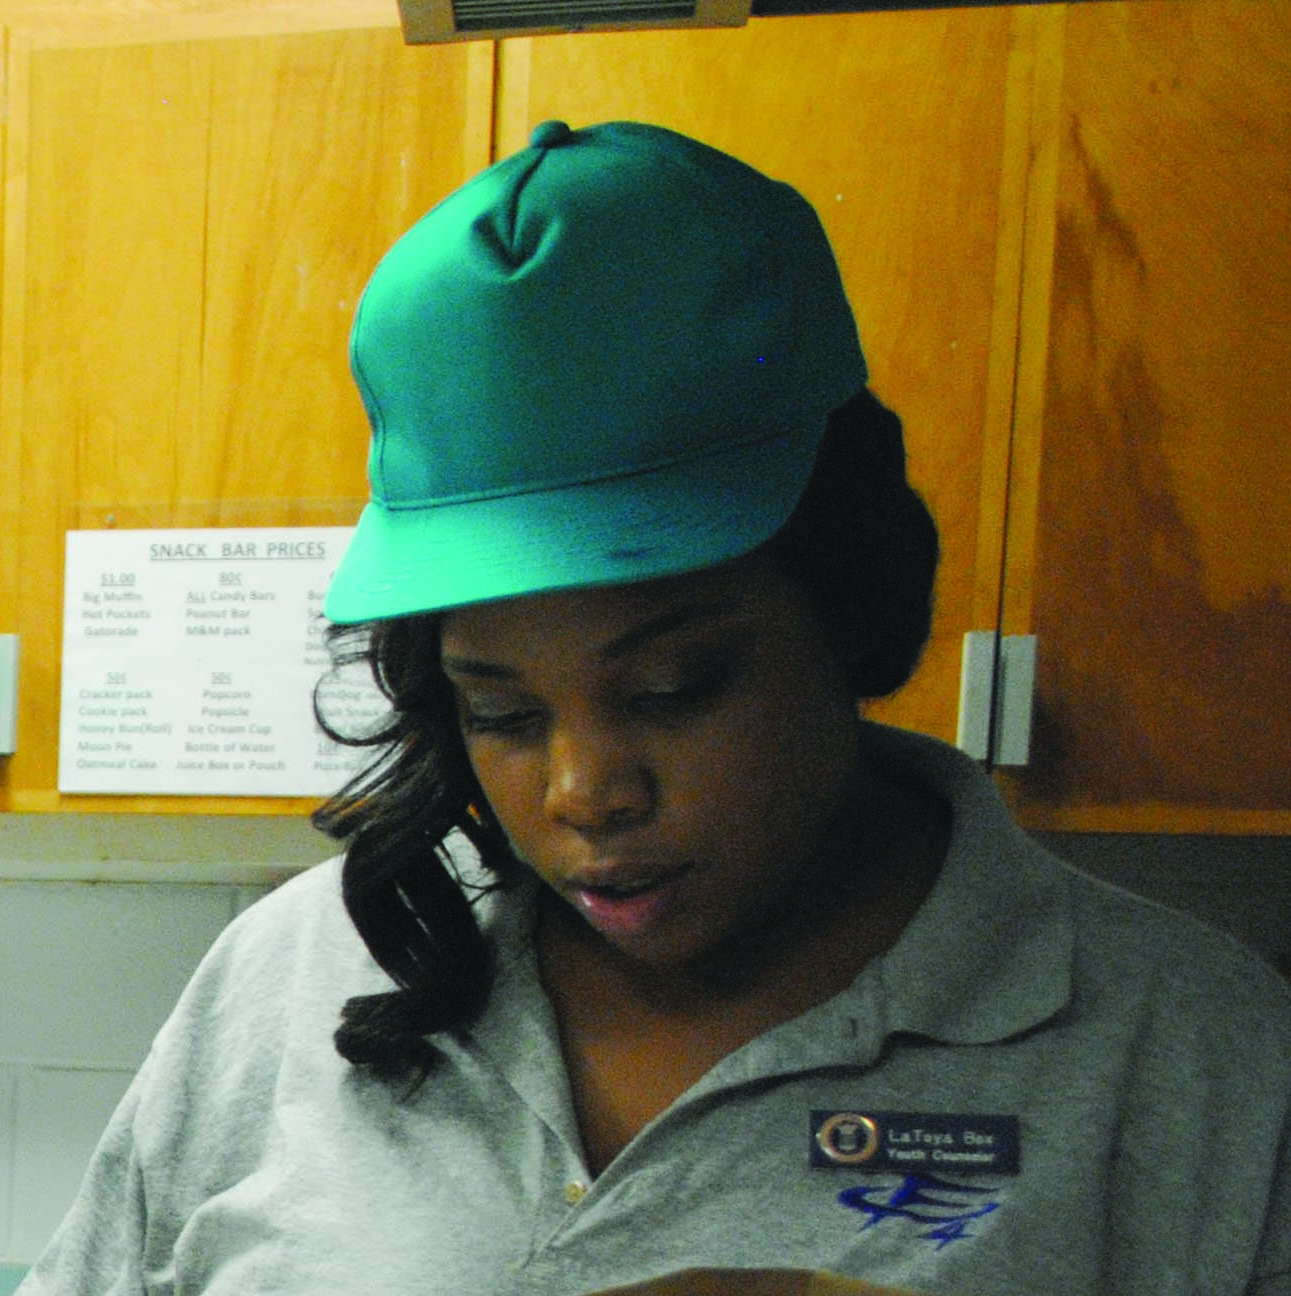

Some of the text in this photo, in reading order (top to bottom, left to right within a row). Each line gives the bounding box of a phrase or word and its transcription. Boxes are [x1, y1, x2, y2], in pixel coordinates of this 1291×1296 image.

[150, 542, 326, 558] SNACK BAR PRICES
[210, 590, 247, 602] Candy
[250, 590, 277, 601] Bars
[82, 609, 103, 619] Hot
[186, 608, 251, 619] Peanut Bar
[84, 626, 139, 636] Gatorade
[186, 626, 251, 638] M&M pack
[126, 689, 153, 701] pack
[203, 689, 251, 701] Popcorn
[121, 706, 148, 718] pack
[201, 706, 249, 718] Popsicle
[187, 723, 272, 736] Ice Cream Cup
[185, 741, 275, 752] Bottle of Water
[208, 760, 229, 770] Box
[249, 760, 286, 770] Pouch
